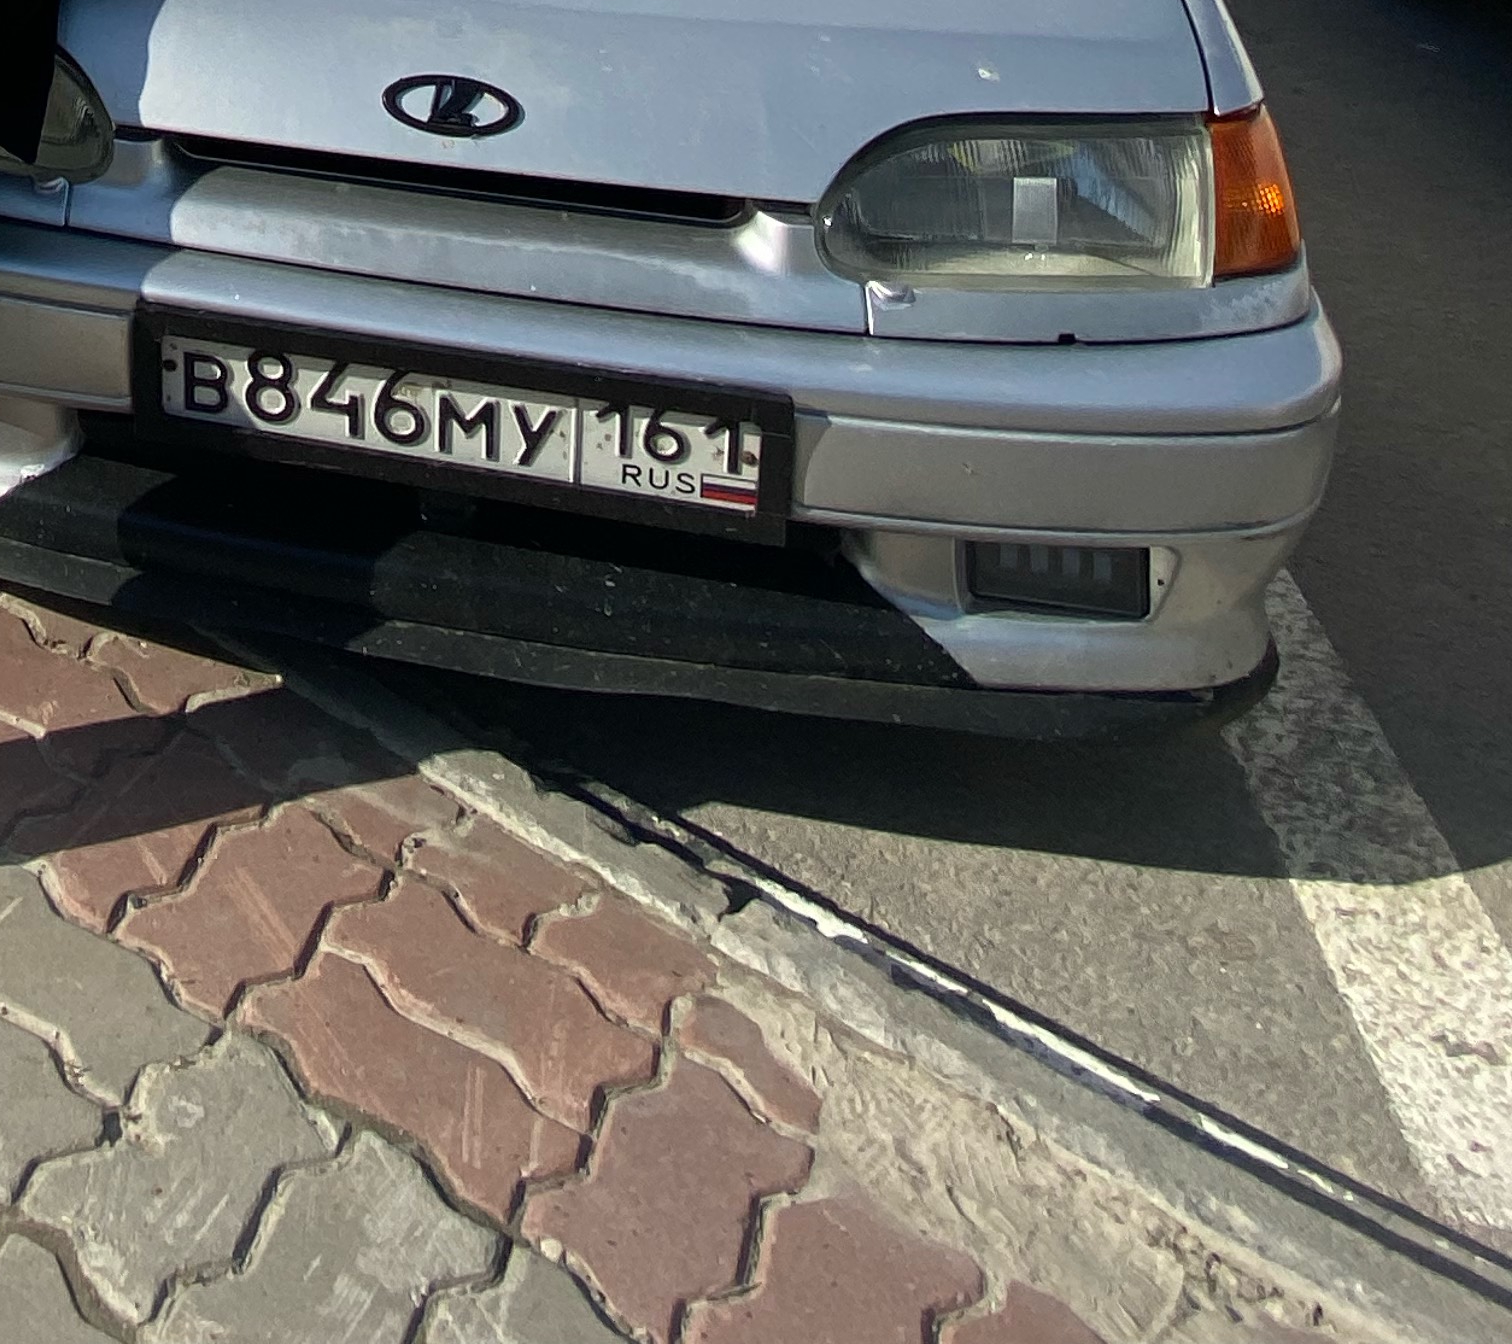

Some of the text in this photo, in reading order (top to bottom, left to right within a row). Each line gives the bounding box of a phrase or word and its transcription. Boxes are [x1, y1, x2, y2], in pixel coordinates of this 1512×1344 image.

[184, 348, 745, 475] В846МУ 161
[621, 464, 696, 495] RUS
